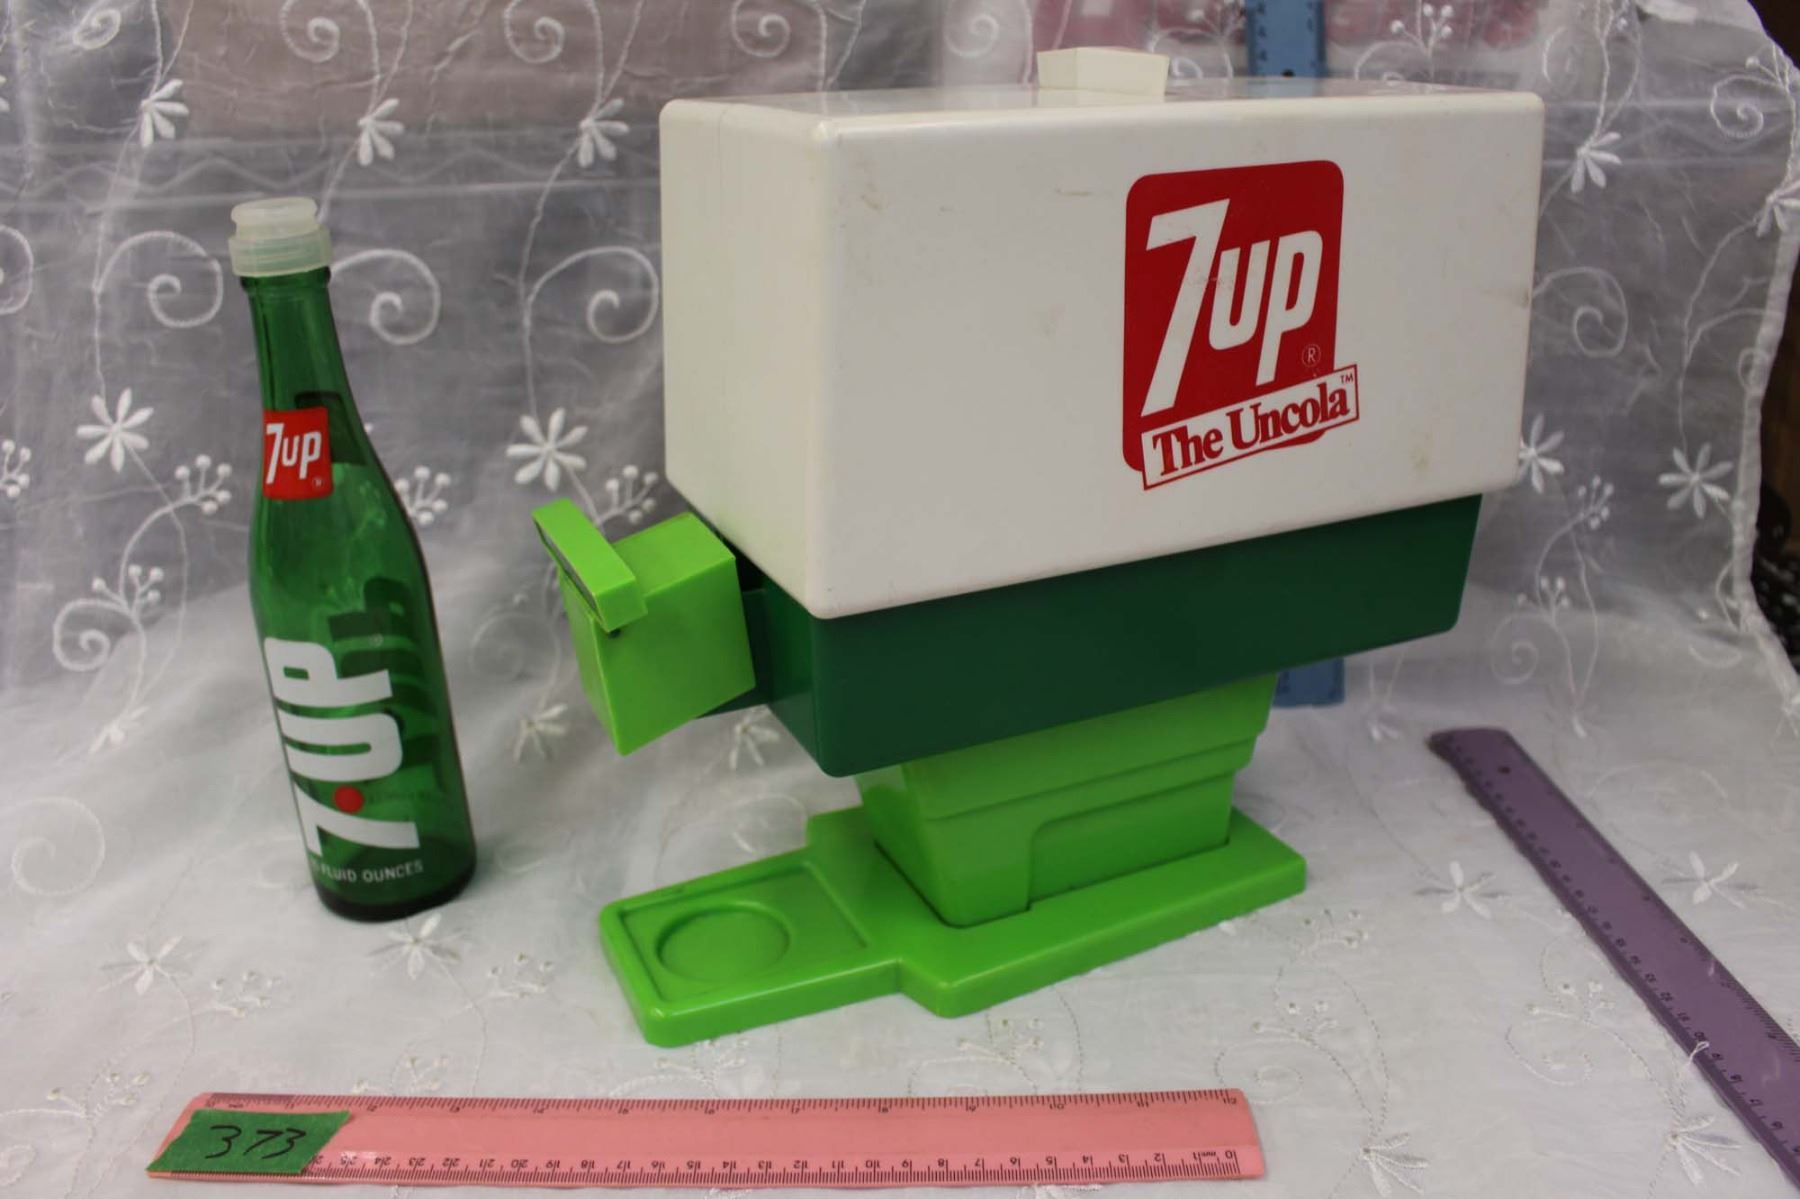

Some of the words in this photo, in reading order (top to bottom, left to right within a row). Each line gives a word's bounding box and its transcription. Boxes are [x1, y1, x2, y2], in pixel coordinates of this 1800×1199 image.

[1153, 425, 1223, 476] The
[1226, 382, 1350, 450] Uncola
[362, 859, 424, 883] OUNCES
[205, 1125, 307, 1160] 373
[374, 1156, 392, 1166] 24
[408, 1157, 426, 1166] 23
[442, 1157, 461, 1167] 22
[479, 1158, 496, 1168] 21
[511, 1159, 528, 1168] 20
[545, 1159, 561, 1169] 19
[581, 1159, 595, 1169] 18
[616, 1160, 631, 1169] 17
[651, 1160, 666, 1169] 16
[686, 1160, 701, 1169] 15
[722, 1160, 737, 1169] 14
[758, 1160, 772, 1169] 13
[793, 1160, 808, 1169] 12
[832, 1160, 845, 1169] 11
[865, 1160, 880, 1168] 10
